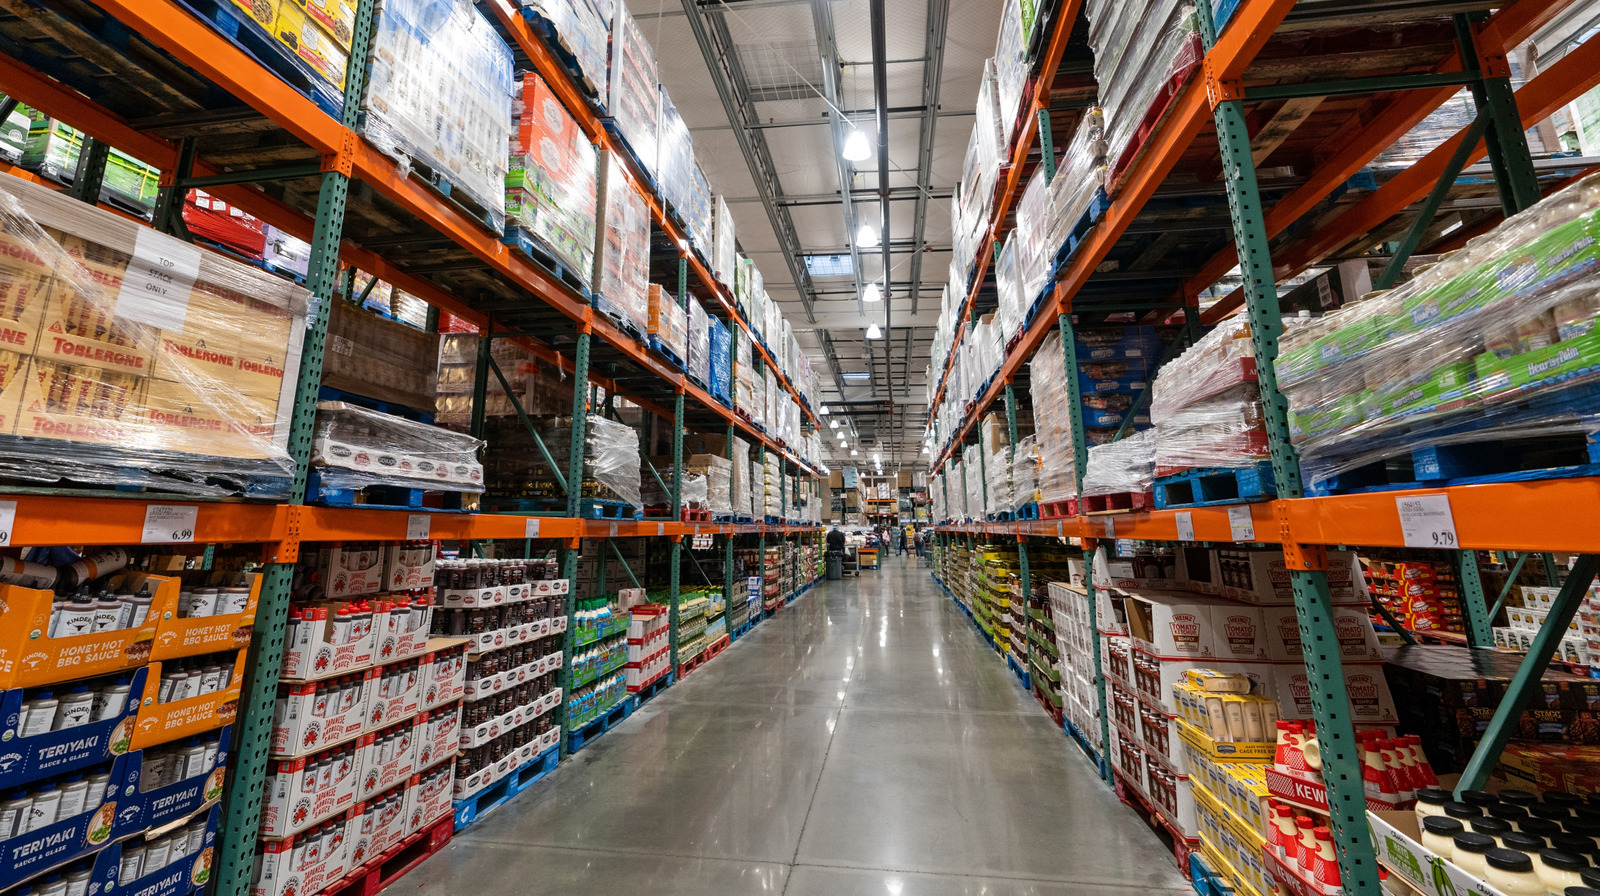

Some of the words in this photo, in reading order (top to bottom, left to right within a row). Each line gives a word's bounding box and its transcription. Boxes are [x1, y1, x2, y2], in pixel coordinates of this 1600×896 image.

[158, 257, 175, 269] TOP
[149, 268, 174, 284] STACK
[145, 283, 168, 297] ONLY
[53, 336, 144, 369] TOBLERONE
[163, 338, 234, 367] TOBLERONE
[1528, 359, 1554, 377] Hearts
[1558, 346, 1580, 365] Palm
[149, 408, 222, 432] TOBLERONE
[172, 529, 192, 540] 6.99
[1431, 531, 1454, 545] 9.79
[1120, 580, 1140, 589] HEINZ
[183, 636, 200, 646] BBQ
[202, 632, 229, 643] SAUCE
[185, 626, 214, 637] HONEY
[215, 624, 231, 632] HOT
[60, 642, 100, 657] HONEY
[101, 640, 124, 651] HOT
[57, 657, 82, 668] BBQ
[85, 649, 121, 663] SAUCE
[334, 661, 350, 671] SAUCE
[167, 705, 198, 720] HONEY
[198, 701, 216, 713] HOT
[1534, 710, 1561, 719] STAGG
[165, 718, 183, 730] BBQ
[185, 710, 214, 724] SAUCE
[323, 715, 346, 730] JAPANESE
[323, 732, 340, 744] SAUCE
[38, 735, 99, 761] TERIYAKI
[39, 758, 61, 770] SAUCE
[69, 751, 90, 762] GLAZE
[152, 786, 198, 811] TERIYAKI
[314, 786, 337, 805] JAPANESE
[314, 805, 331, 819] SAUCE
[12, 826, 76, 860] TERIYAKI
[13, 856, 37, 870] SAUCE
[45, 844, 67, 858] GLAZE
[1276, 862, 1304, 896] KEWPIE
